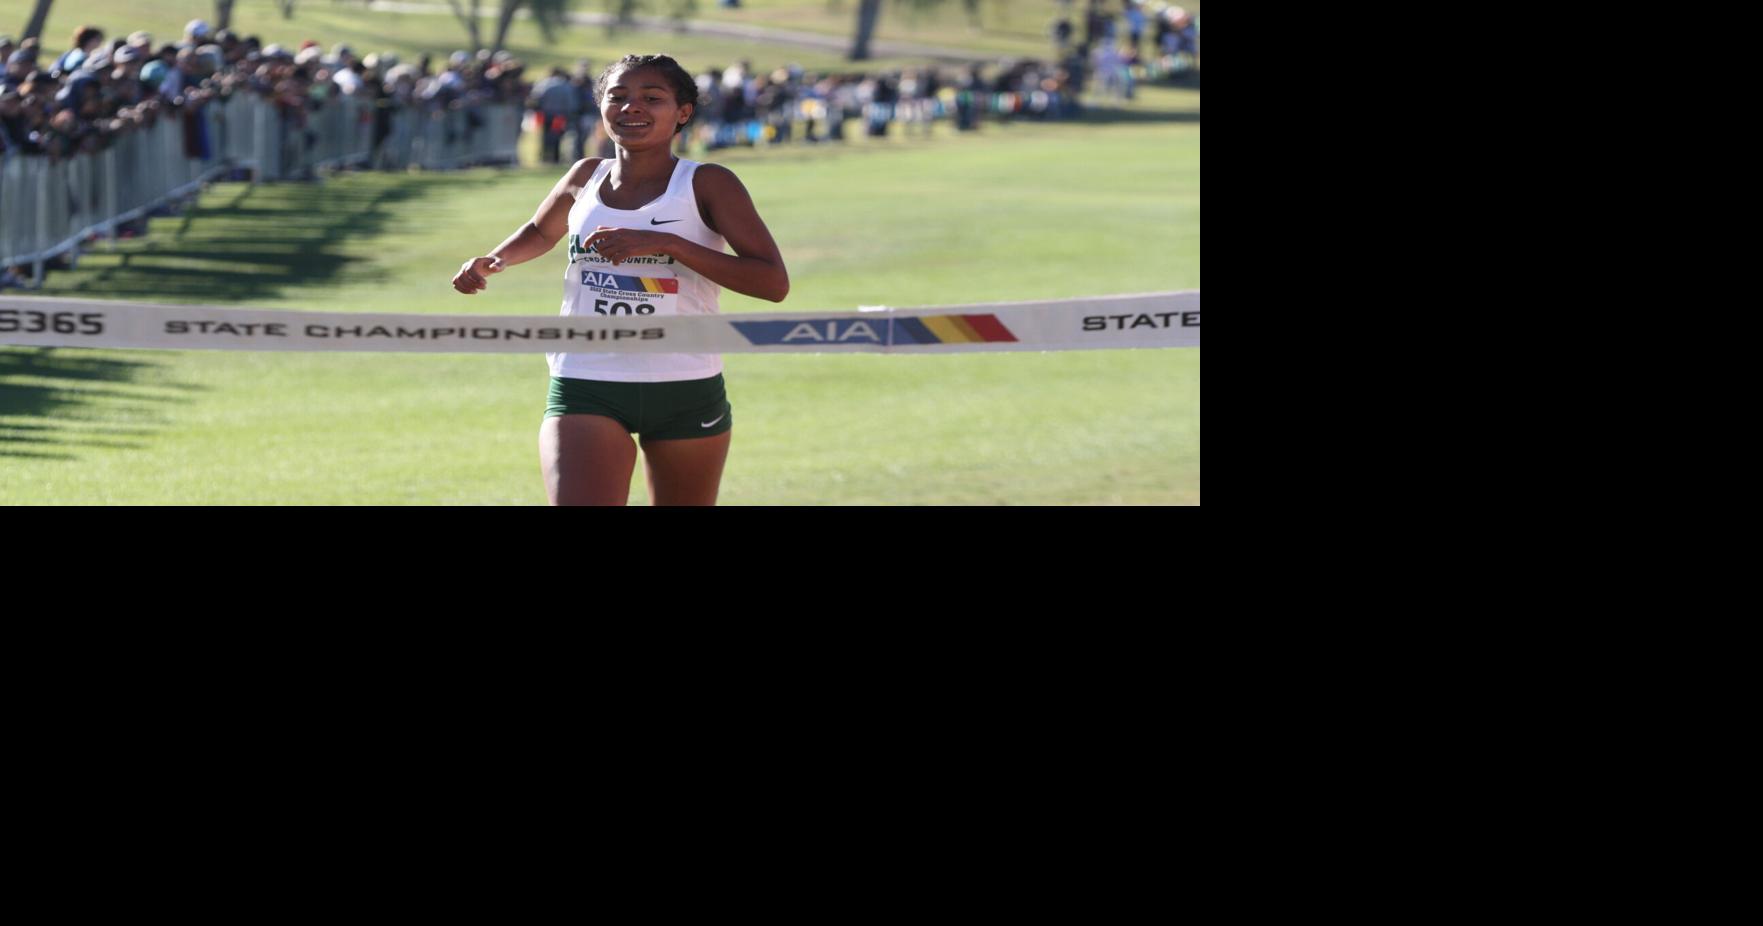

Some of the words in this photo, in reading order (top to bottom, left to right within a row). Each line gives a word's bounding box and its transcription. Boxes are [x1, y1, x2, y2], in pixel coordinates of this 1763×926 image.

[583, 271, 620, 289] AIA
[164, 320, 288, 337] STATE
[304, 324, 666, 341] CHAMPIONSHIPS
[781, 321, 880, 341] AIA
[1082, 311, 1200, 331] STATE
